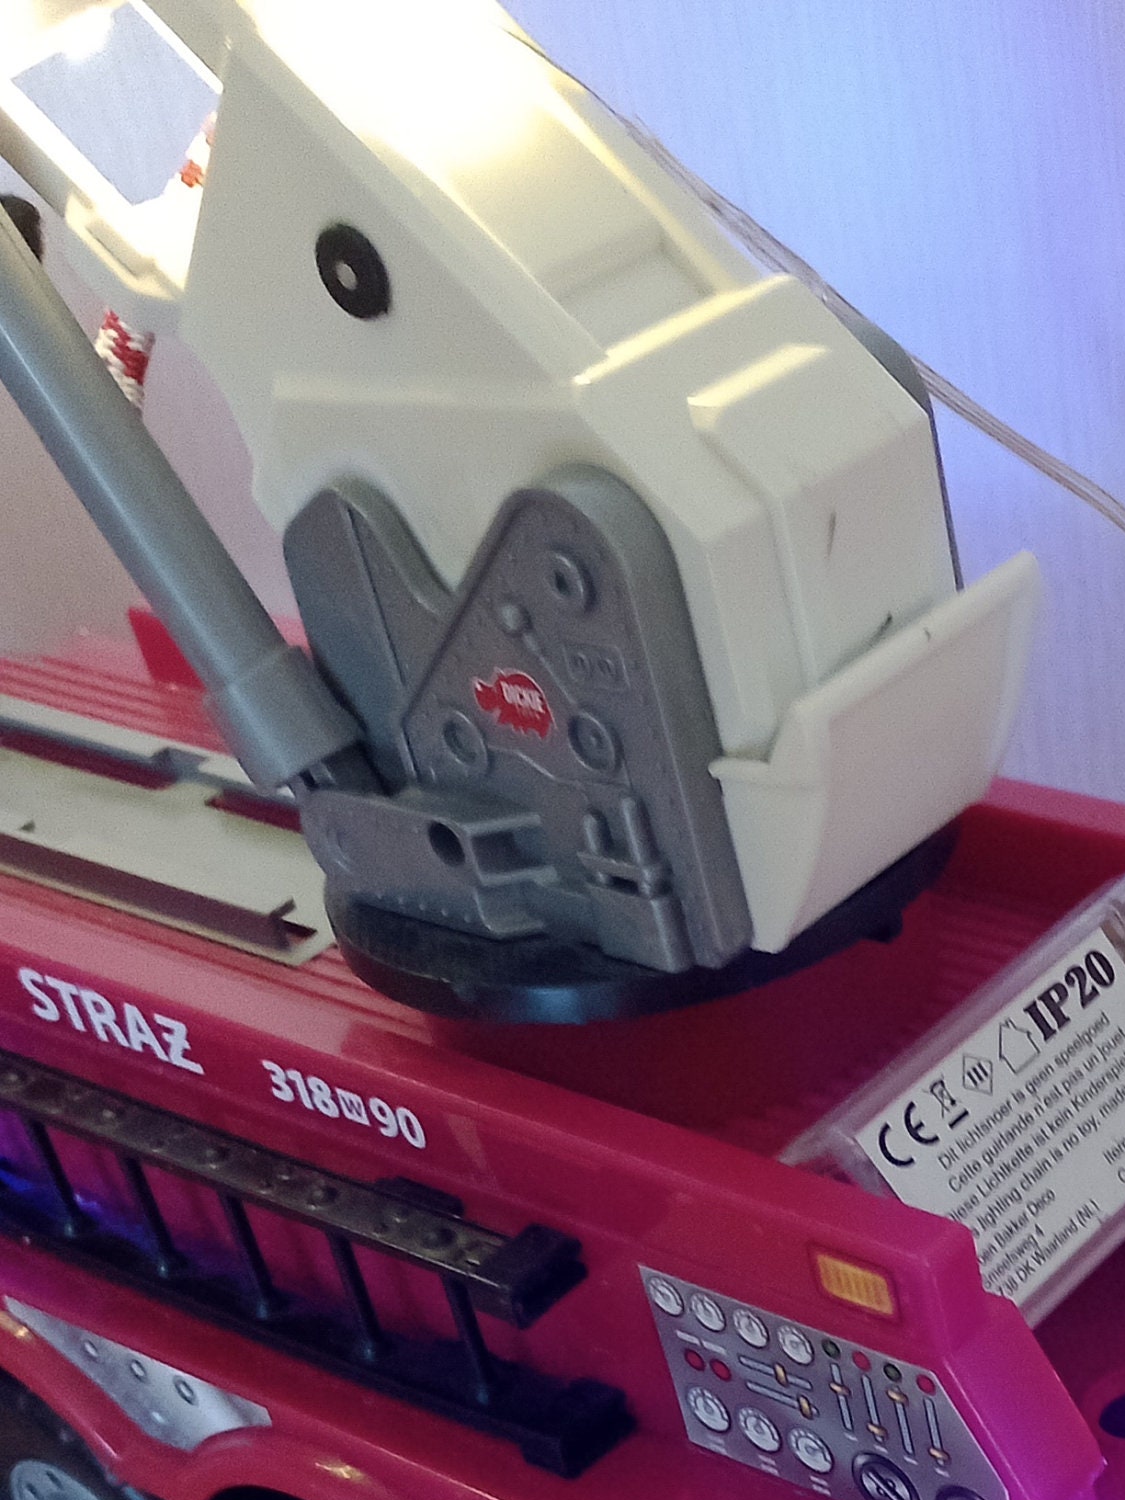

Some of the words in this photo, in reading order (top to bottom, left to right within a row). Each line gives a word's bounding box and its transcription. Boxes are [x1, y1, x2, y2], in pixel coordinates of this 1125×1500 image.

[1023, 949, 1116, 1042] IP20
[937, 1145, 959, 1170] Dit
[1010, 1086, 1025, 1104] is
[1023, 1062, 1057, 1097] geen
[1051, 1010, 1113, 1072] speelgoed
[946, 1156, 983, 1194] Cette
[977, 1107, 1037, 1167] guirlande
[1060, 1066, 1086, 1094] pas
[1081, 1052, 1100, 1073] un
[974, 1183, 1024, 1234] lighting
[1016, 1153, 1053, 1193] chain
[1048, 1143, 1065, 1164] is
[1061, 1132, 1080, 1153] no
[975, 1140, 1036, 1199] Lichtkette
[1030, 1125, 1050, 1149] ist
[1044, 1103, 1074, 1136] kein
[992, 1208, 1032, 1249] Bakker
[1025, 1184, 1057, 1218] Deco
[1014, 1258, 1036, 1283] DK
[1028, 1215, 1080, 1267] Waarland
[1032, 1222, 1045, 1238] 4
